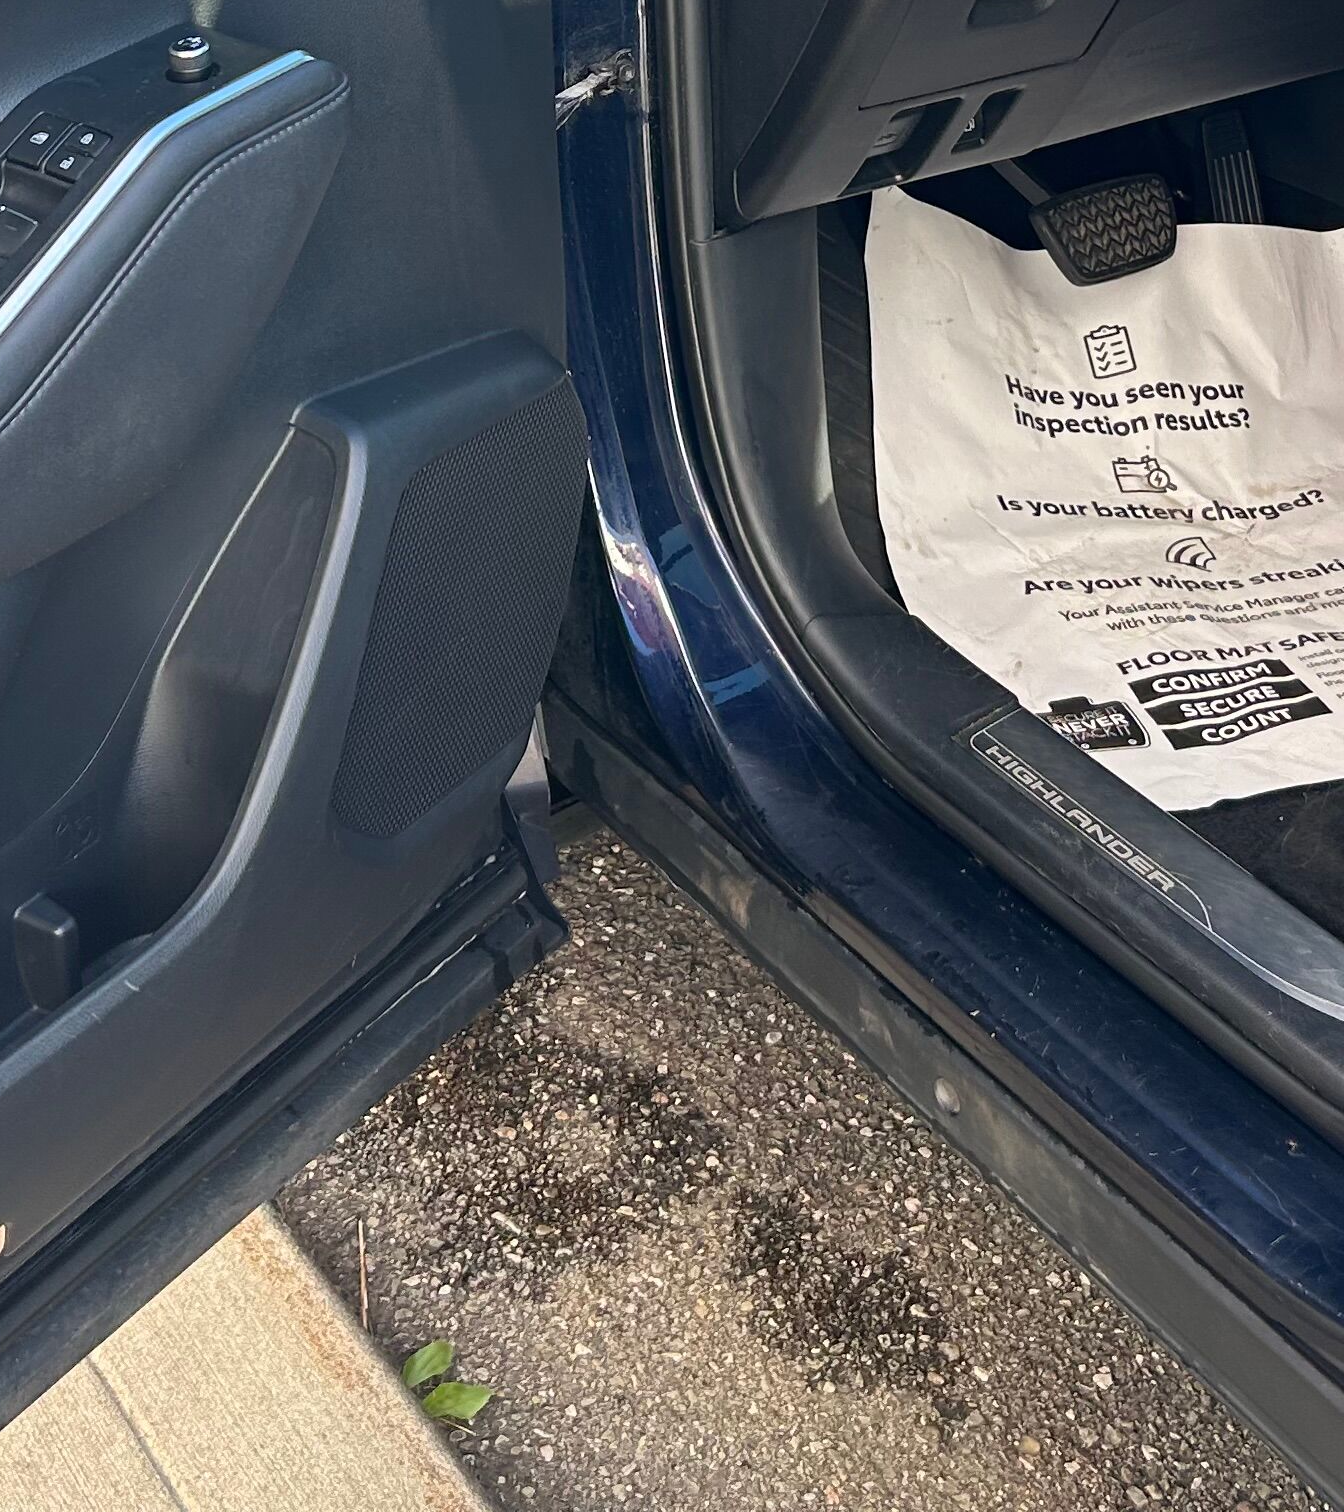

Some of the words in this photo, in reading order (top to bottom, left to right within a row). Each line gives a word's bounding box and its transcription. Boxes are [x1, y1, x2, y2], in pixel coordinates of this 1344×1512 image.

[1005, 373, 1065, 406] Have
[1068, 388, 1120, 410] you
[1125, 381, 1186, 405] seen
[1187, 383, 1245, 407] your
[1013, 402, 1150, 438] inspection
[1155, 407, 1251, 431] results?
[996, 494, 1023, 512] Is
[1024, 499, 1088, 517] your
[1090, 500, 1194, 523] battery
[1201, 488, 1326, 521] charged?
[1024, 578, 1074, 595] Are
[1076, 575, 1143, 594] your
[1146, 573, 1245, 592] wipers
[1058, 607, 1100, 622] Your
[1104, 600, 1183, 615] Assistant
[1244, 591, 1320, 609] Manager
[1105, 616, 1146, 631] with
[1147, 613, 1197, 625] these
[1116, 648, 1210, 675] FLOOR
[1213, 640, 1275, 663] MAT
[1152, 661, 1273, 694] CONFIRM
[1179, 684, 1281, 719] SECURE
[1051, 713, 1130, 735] NEVER
[1201, 707, 1294, 744] COUNT
[984, 744, 1176, 893] HIGHLANDER
